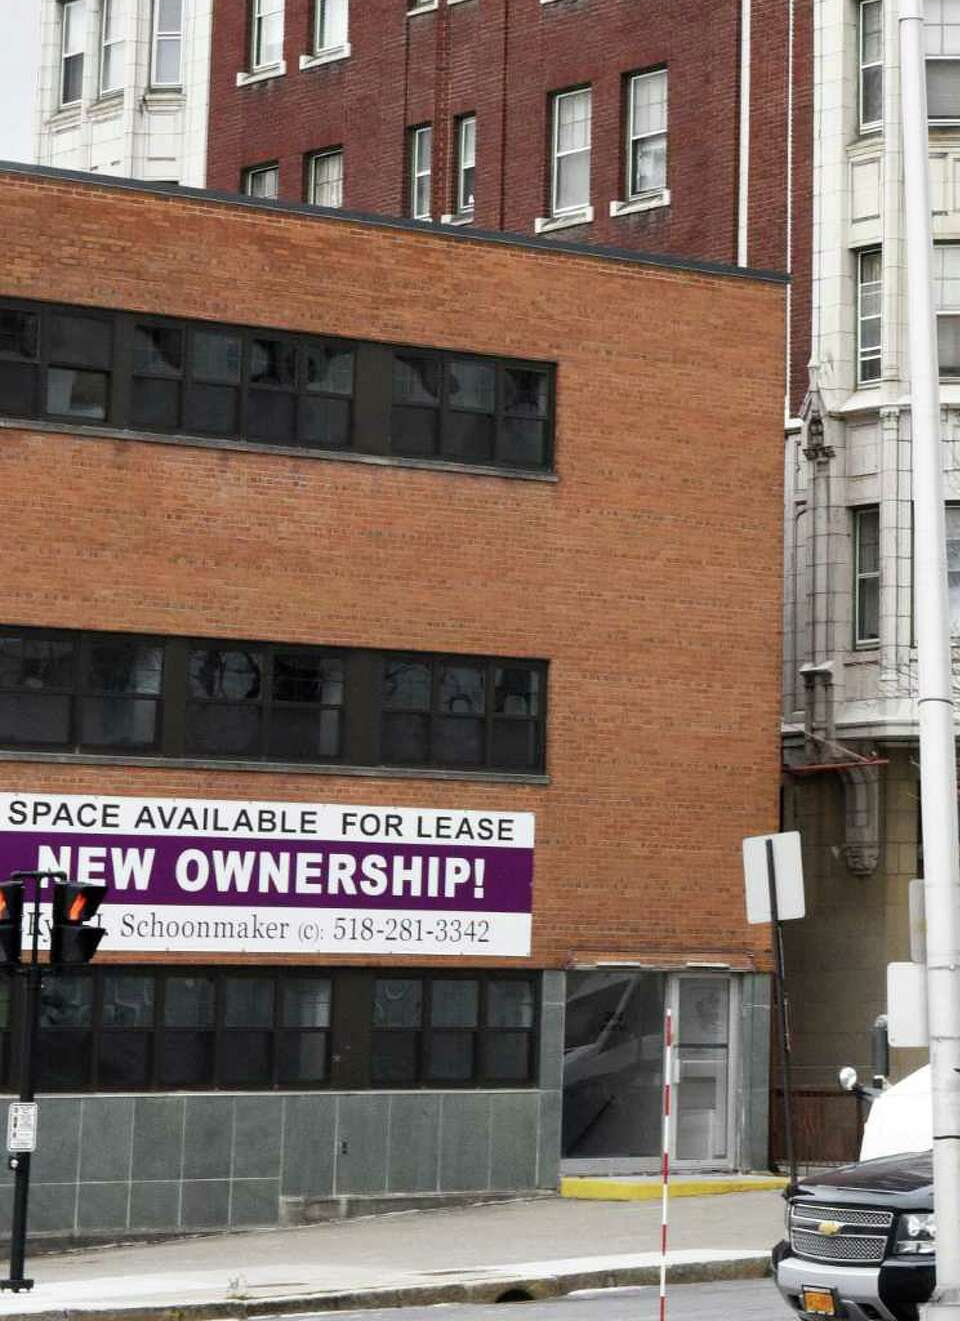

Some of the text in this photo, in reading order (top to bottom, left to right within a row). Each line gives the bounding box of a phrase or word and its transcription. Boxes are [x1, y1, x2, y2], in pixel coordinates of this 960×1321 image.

[8, 800, 515, 841] SPACE AVAILABLE FOR LEASE
[37, 845, 486, 899] NEW OWNERSHIP!
[121, 911, 290, 940] Schoonmaker
[298, 921, 324, 941] (c):
[333, 916, 490, 943] 518-281-3342
